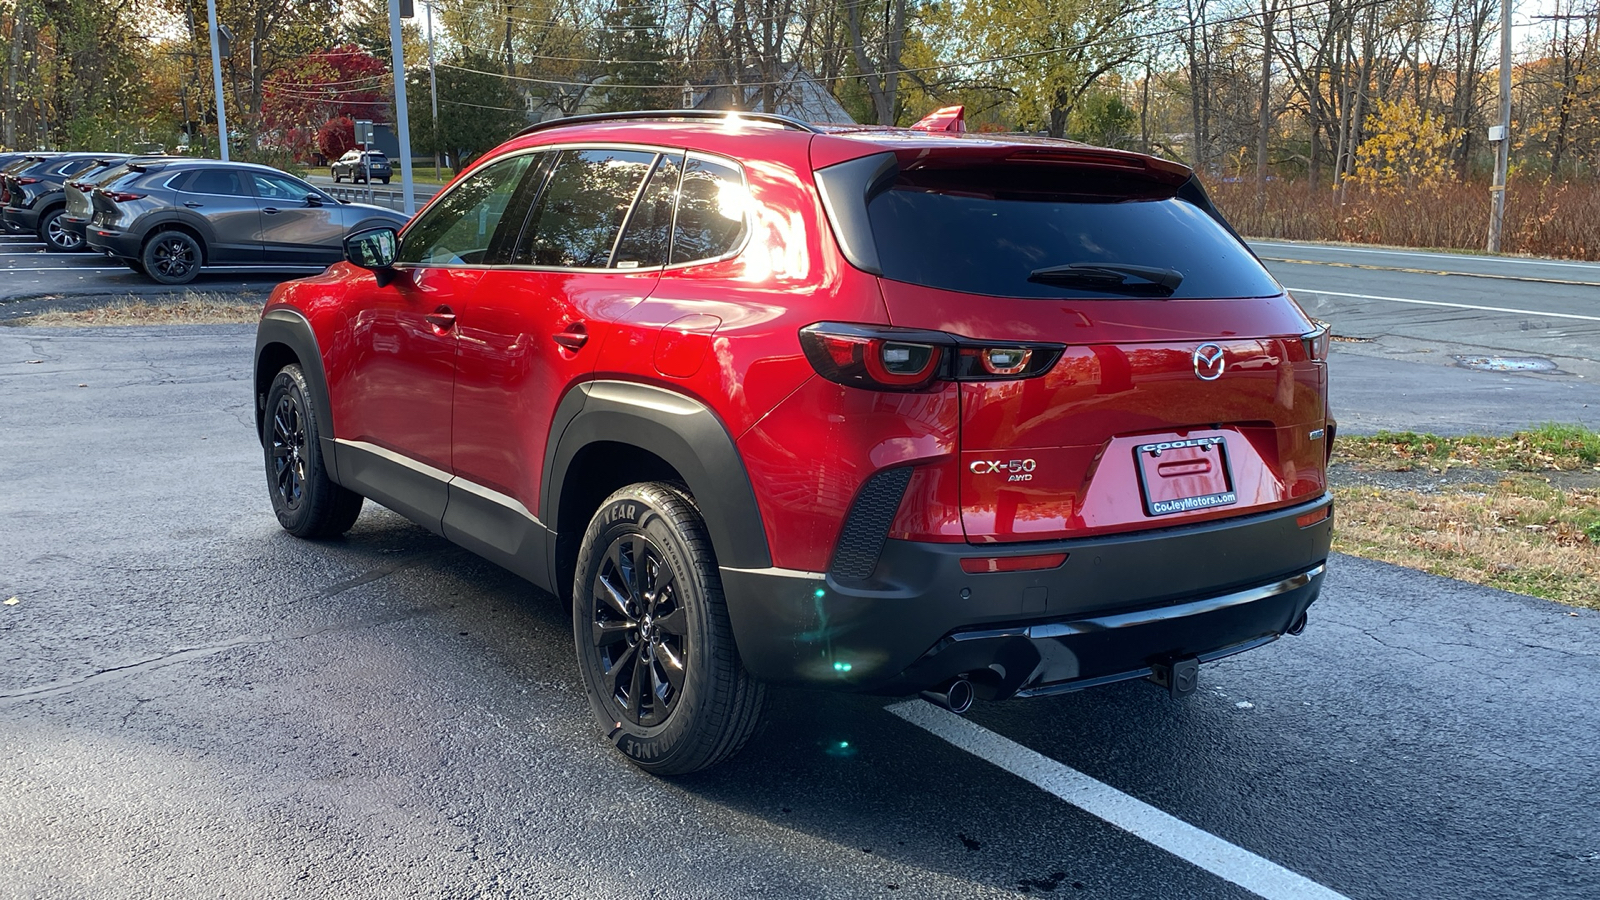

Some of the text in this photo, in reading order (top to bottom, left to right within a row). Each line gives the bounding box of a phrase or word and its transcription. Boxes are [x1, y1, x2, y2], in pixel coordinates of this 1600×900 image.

[1142, 437, 1221, 452] COOLEY
[969, 458, 1037, 475] CX-50
[1008, 473, 1033, 482] AWD
[1153, 493, 1236, 512] CooleyMotors.com
